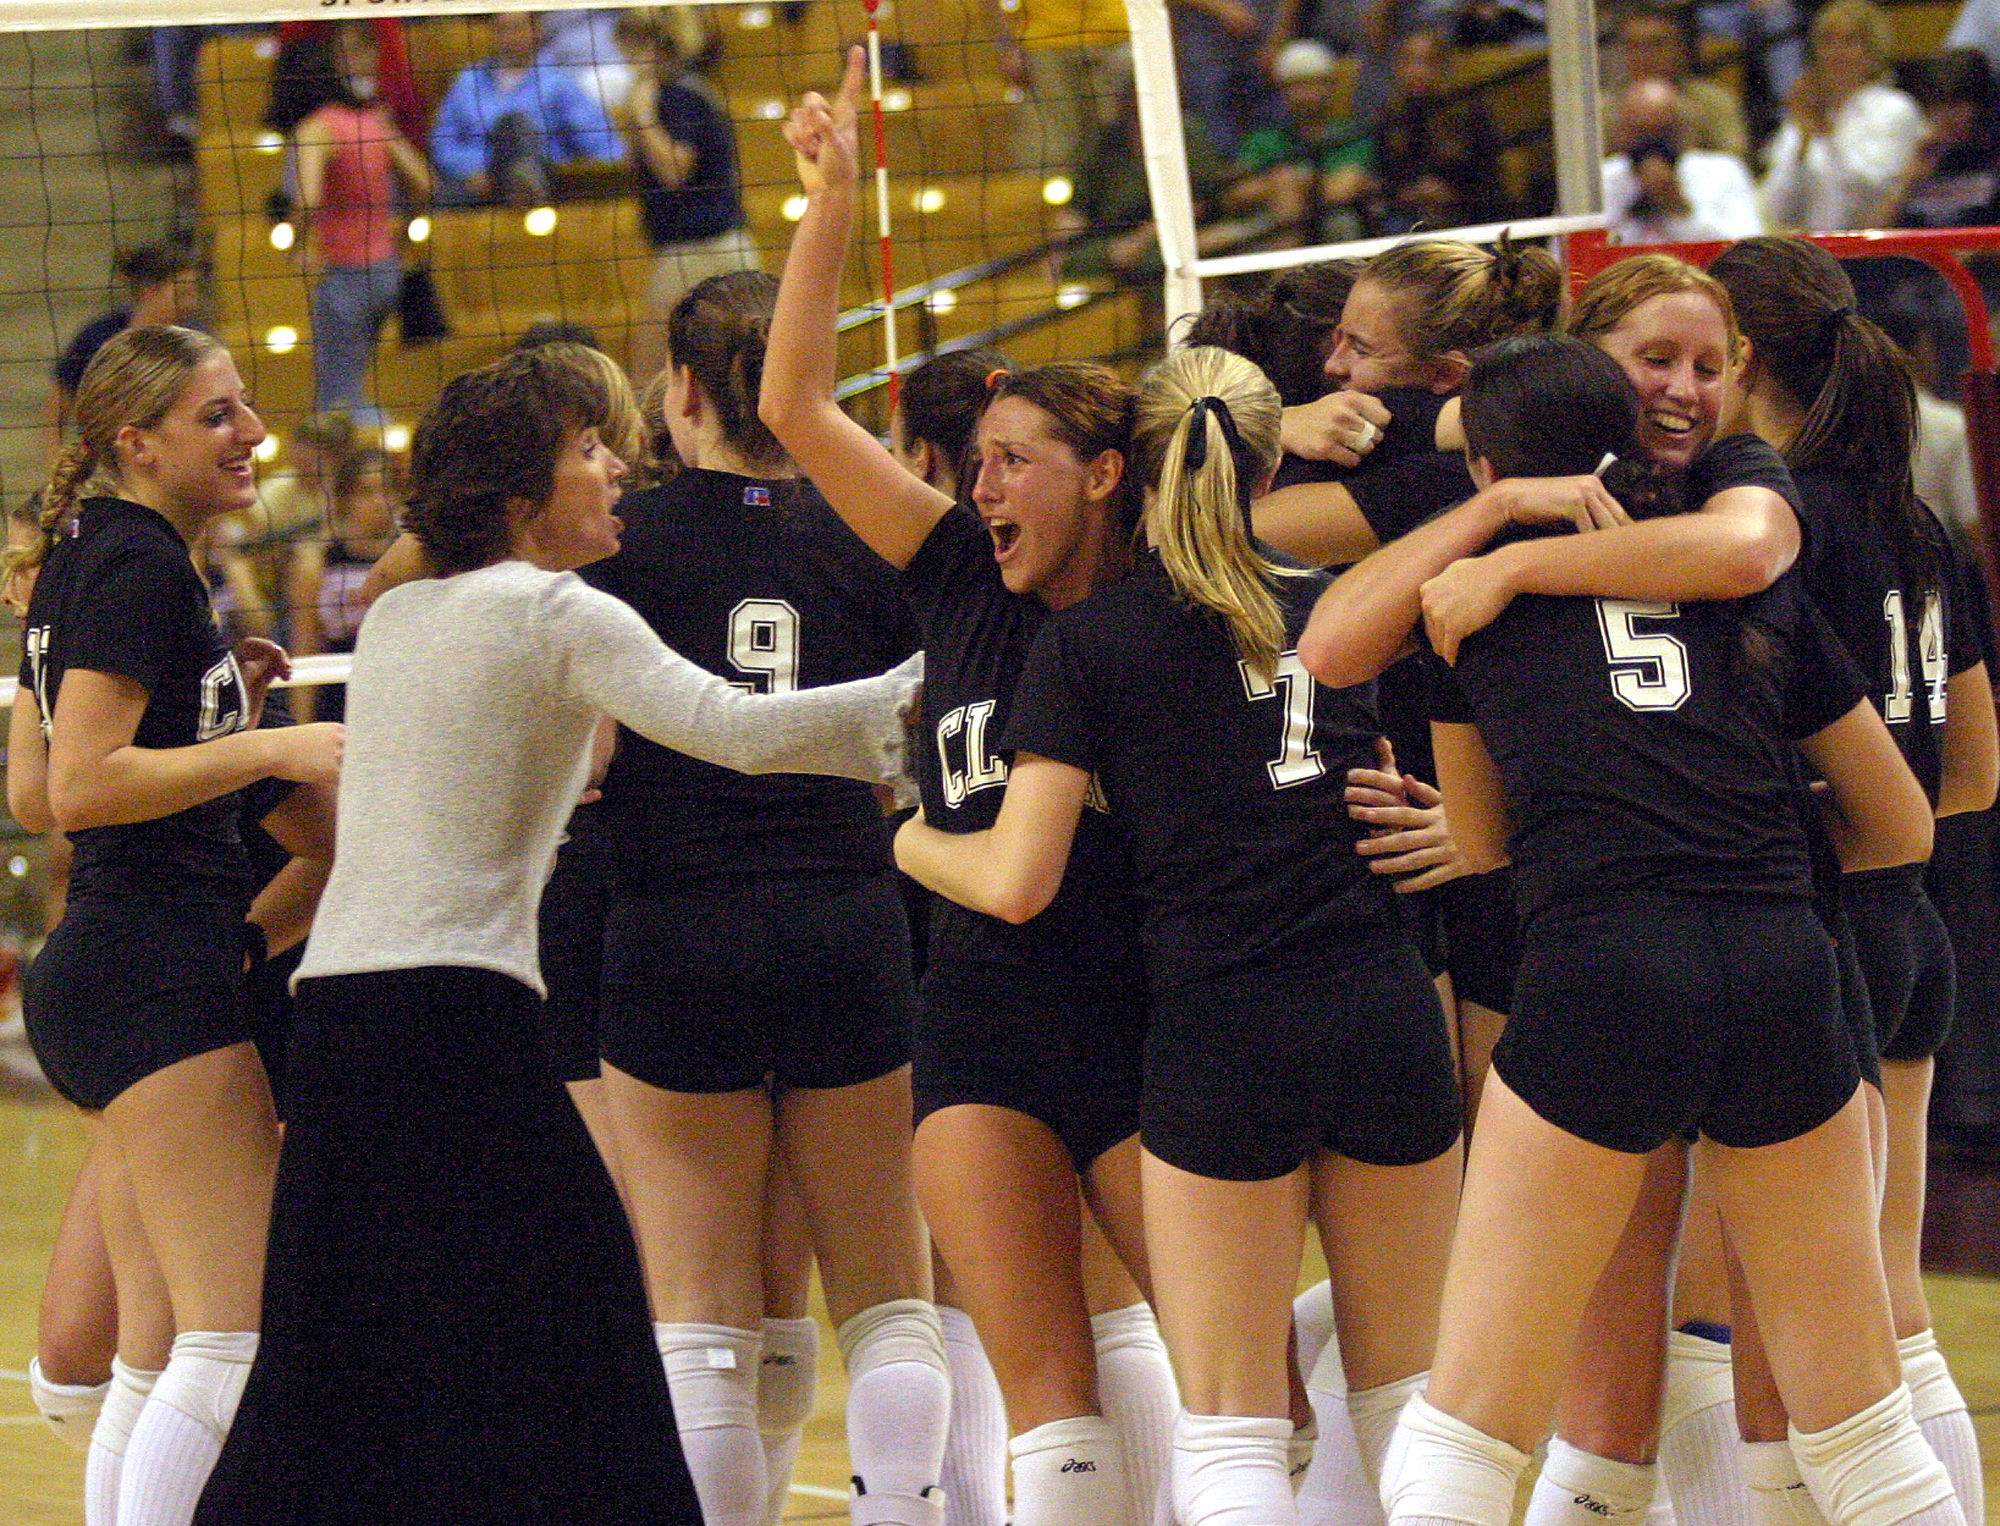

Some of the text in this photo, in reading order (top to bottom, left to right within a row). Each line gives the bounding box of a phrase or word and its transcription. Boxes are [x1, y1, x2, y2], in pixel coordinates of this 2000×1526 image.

[726, 598, 800, 695] 9
[1594, 599, 1692, 712] 5
[1883, 589, 1949, 724] 14
[1237, 649, 1327, 791] 7
